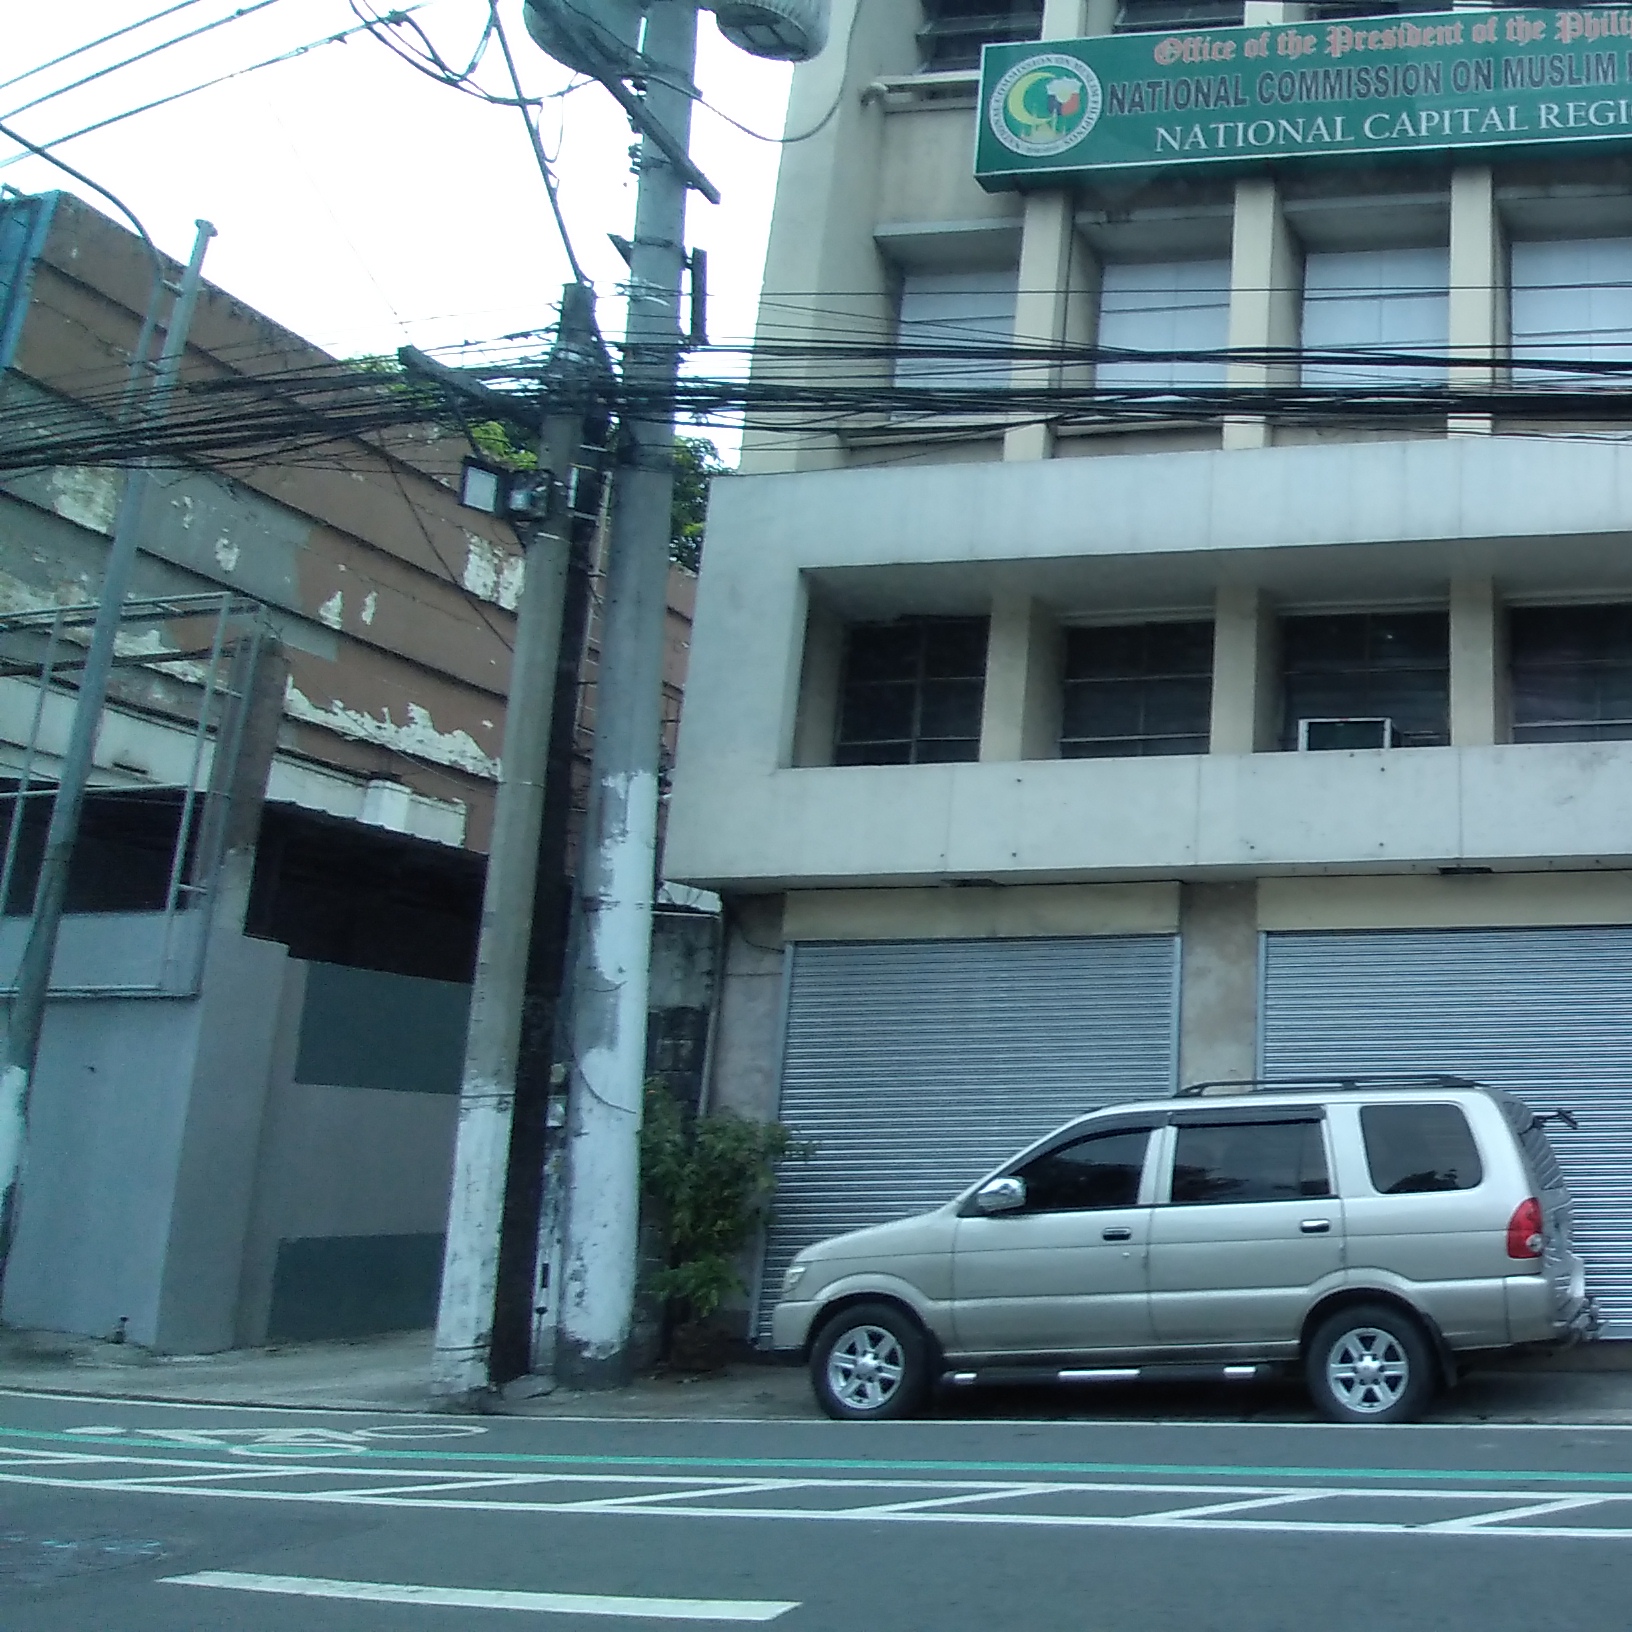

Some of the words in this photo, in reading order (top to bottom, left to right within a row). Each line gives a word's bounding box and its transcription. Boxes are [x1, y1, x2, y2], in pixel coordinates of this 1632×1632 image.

[1154, 31, 1237, 65] Office
[1244, 31, 1271, 58] of
[1277, 29, 1316, 57] the
[1325, 20, 1463, 58] President
[1472, 17, 1498, 44] of
[1505, 16, 1547, 46] the
[1107, 75, 1249, 116] NATIONAL
[1256, 61, 1443, 106] COMMISSION
[1451, 58, 1495, 95] ON
[1503, 51, 1618, 91] MUSLIM
[1154, 116, 1354, 153] NATIONAL
[1363, 106, 1529, 141] CAPITAL
